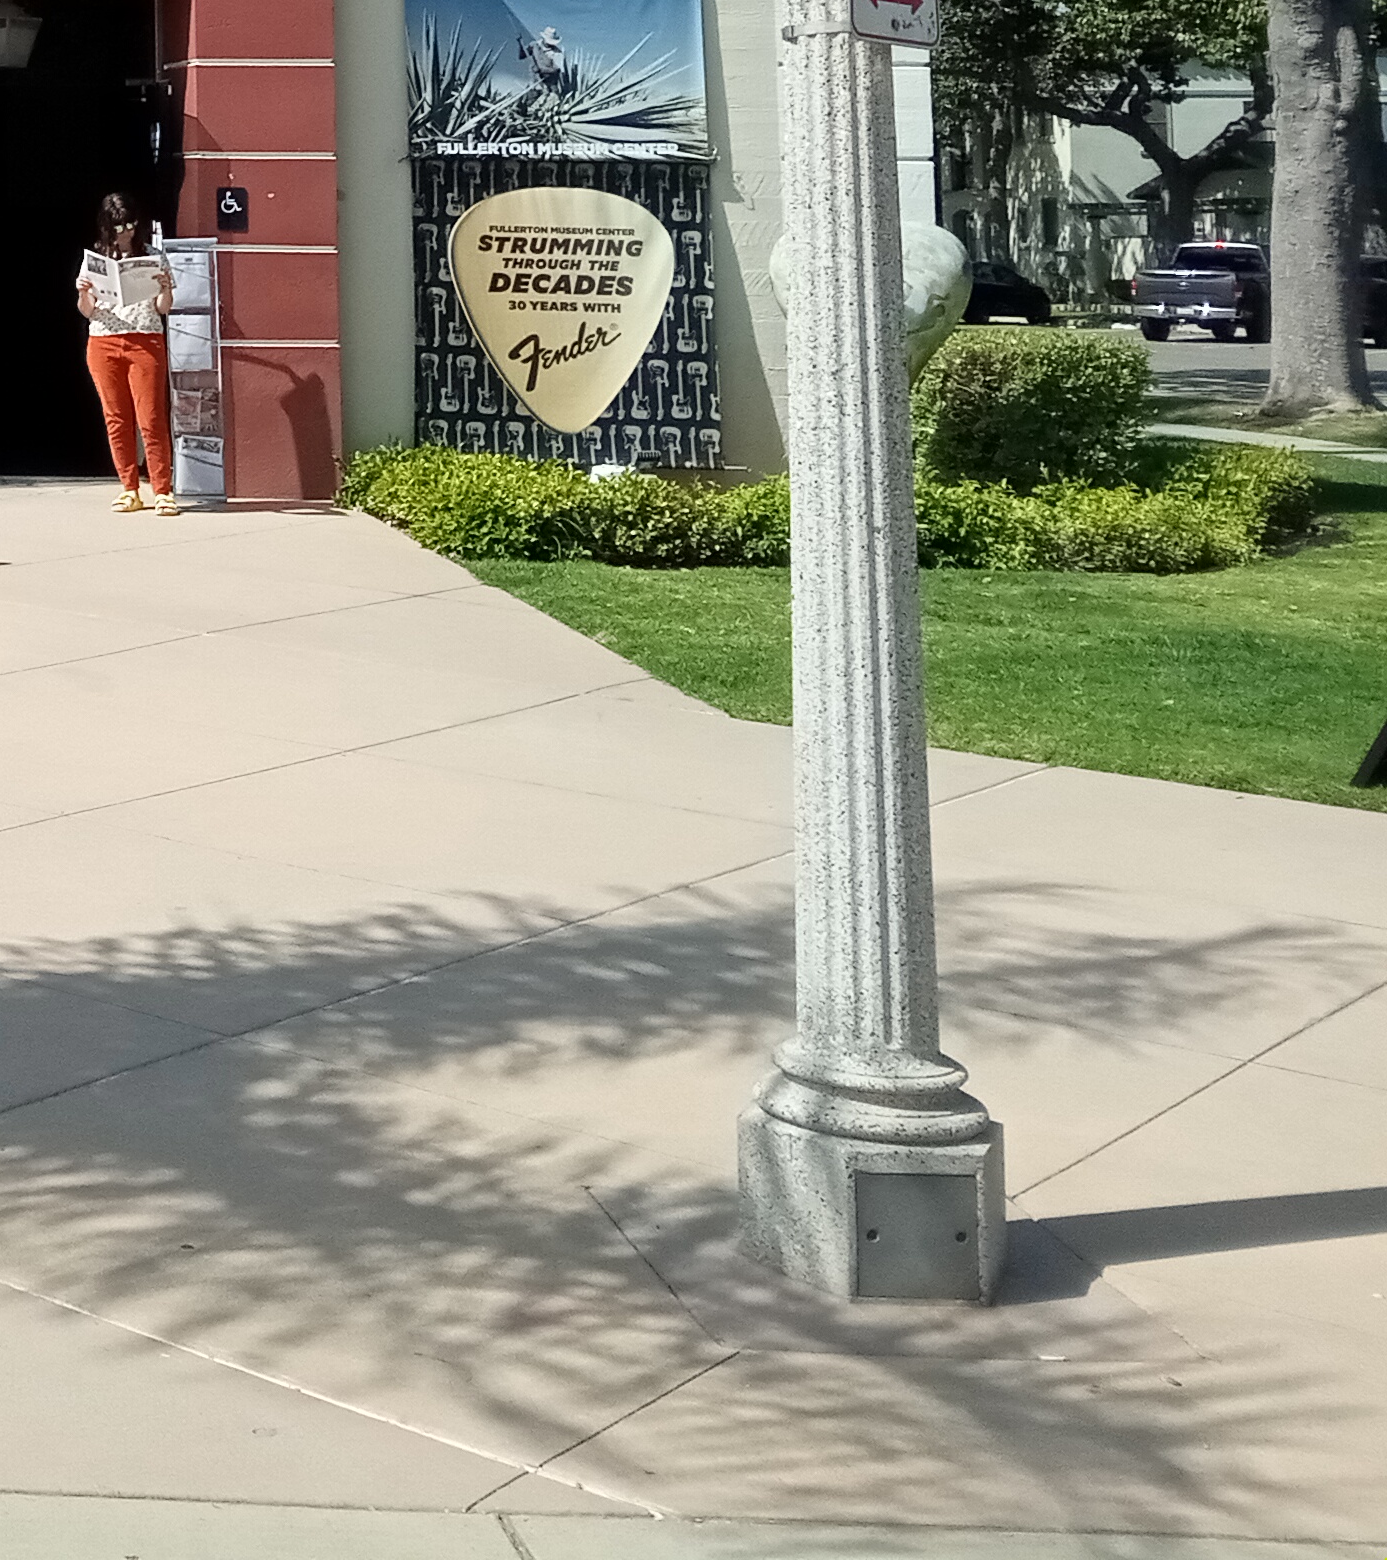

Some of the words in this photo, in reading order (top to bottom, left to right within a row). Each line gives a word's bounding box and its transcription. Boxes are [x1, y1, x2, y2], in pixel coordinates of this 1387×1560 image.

[436, 142, 539, 155] FULLERTON
[541, 143, 608, 155] MUSEUM
[614, 143, 679, 155] CENTER
[489, 225, 549, 235] FULLERTON
[550, 226, 594, 235] MUSEUM
[595, 227, 635, 236] CENTER
[477, 235, 643, 256] STRUMMING
[502, 258, 582, 271] THROUGH
[589, 259, 620, 272] THE
[488, 272, 634, 296] DECADES
[508, 300, 527, 311] 30
[530, 300, 578, 312] YEARS
[583, 302, 622, 313] WITH
[508, 321, 622, 392] Fender
